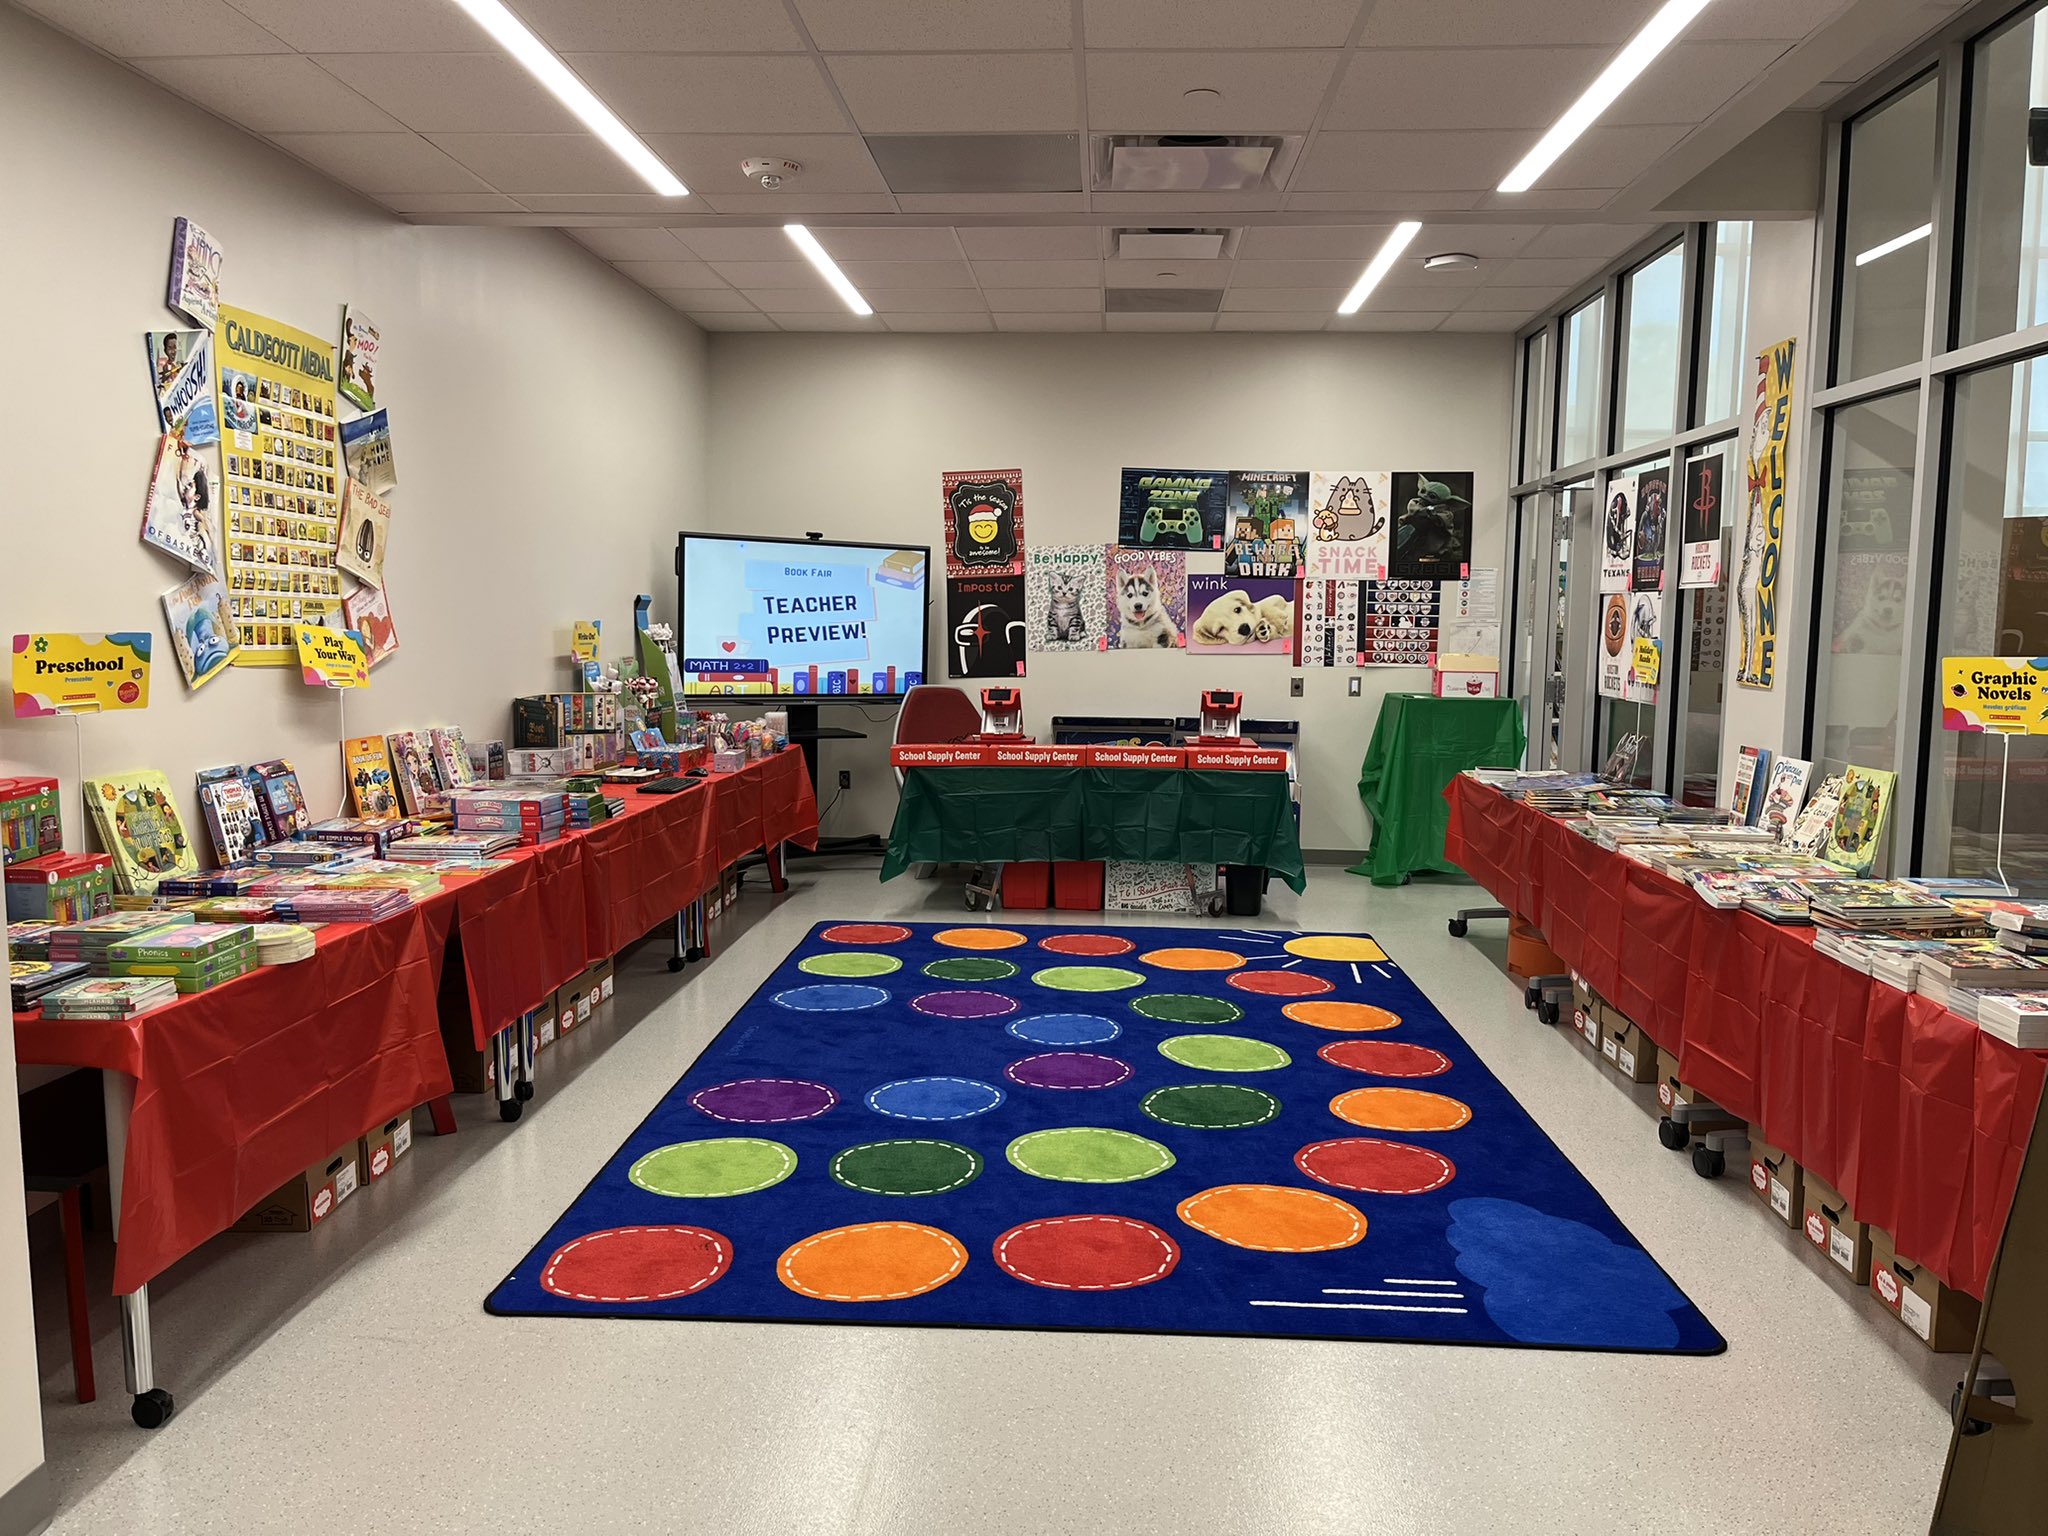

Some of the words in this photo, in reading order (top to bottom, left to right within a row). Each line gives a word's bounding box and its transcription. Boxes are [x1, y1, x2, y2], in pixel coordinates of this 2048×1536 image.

[225, 320, 300, 370] CALDECOTT
[299, 345, 334, 383] MEDAL
[356, 340, 379, 356] MOO!
[170, 348, 206, 415] WHOOSH!
[370, 442, 388, 456] MOON
[373, 452, 390, 465] HOME
[1138, 477, 1212, 490] GAMING
[1240, 473, 1297, 482] MINECRAFT
[353, 484, 364, 500] THE
[365, 492, 378, 509] BAD
[1148, 490, 1200, 501] ZONE
[974, 493, 987, 501] the
[988, 495, 1009, 511] season
[1760, 340, 1793, 688] WELCOME
[969, 548, 1001, 556] awesome!
[1114, 552, 1145, 563] GOOD
[1147, 551, 1177, 563] VIBES
[1318, 547, 1377, 558] SNACK
[1034, 554, 1050, 564] Be
[1054, 554, 1098, 565] Happy
[1691, 554, 1711, 570] ROCKETS
[1238, 562, 1292, 577] DARK
[1318, 559, 1378, 574] TIME
[1603, 569, 1630, 578] TEXANS
[957, 583, 1014, 593] Impostor
[1192, 577, 1228, 591] wink
[763, 595, 857, 614] TEACHER
[767, 621, 867, 644] PREVIEW!
[324, 636, 343, 650] Play
[314, 648, 337, 660] Your
[338, 650, 356, 664] Way
[1639, 644, 1654, 656] Holiday
[35, 656, 124, 675] Preschool
[1639, 655, 1651, 664] Reads
[690, 661, 729, 671] MATH
[1971, 671, 2037, 688] Graphic
[710, 685, 751, 696] ART
[1977, 686, 2032, 701] Novels
[352, 755, 365, 764] BOOK
[900, 751, 926, 761] School
[927, 751, 953, 762] Supply
[955, 751, 981, 760] Center
[997, 751, 1023, 761] School
[1025, 752, 1051, 763] Supply
[1052, 752, 1078, 761] Center
[1095, 752, 1121, 761] School
[1123, 753, 1149, 763] Supply
[1151, 753, 1177, 762] Center
[1197, 754, 1223, 764] School
[1225, 755, 1251, 766] Supply
[1253, 755, 1279, 764] Center
[223, 786, 242, 795] THOMAS
[41, 797, 55, 809] Go
[1137, 883, 1159, 896] Book
[138, 948, 169, 957] Phonics
[218, 954, 236, 964] Phonics
[218, 969, 236, 980] Phonics
